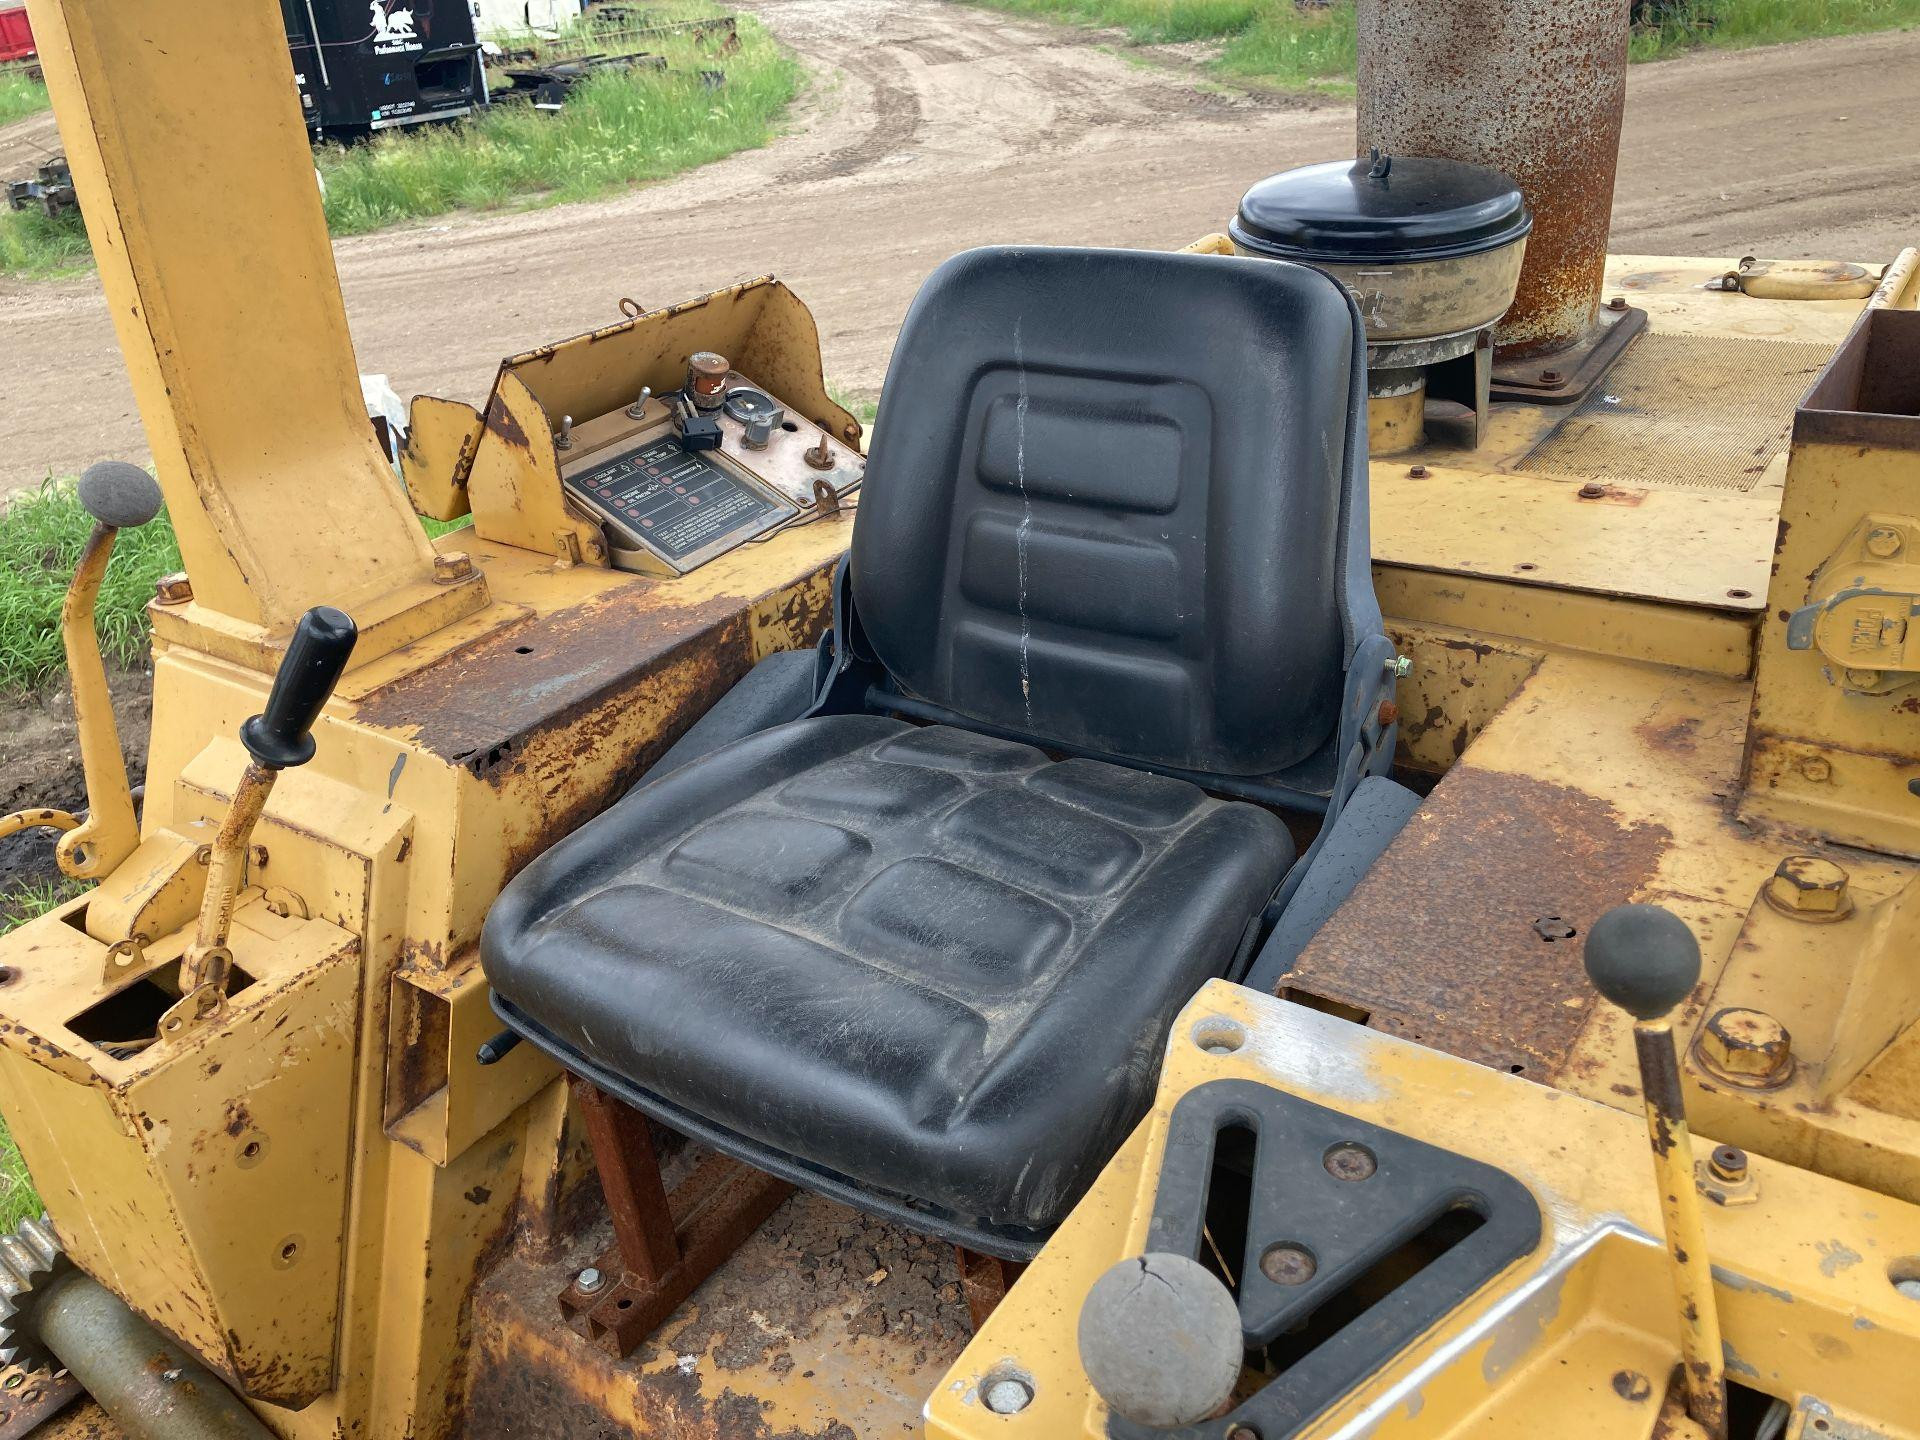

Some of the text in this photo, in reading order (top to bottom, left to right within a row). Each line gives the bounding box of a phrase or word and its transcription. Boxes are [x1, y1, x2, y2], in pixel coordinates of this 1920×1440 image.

[642, 450, 657, 458] TRANS
[594, 468, 617, 480] COOLANT
[671, 466, 697, 479] ALTERNATOR
[622, 490, 639, 499] ENGINE
